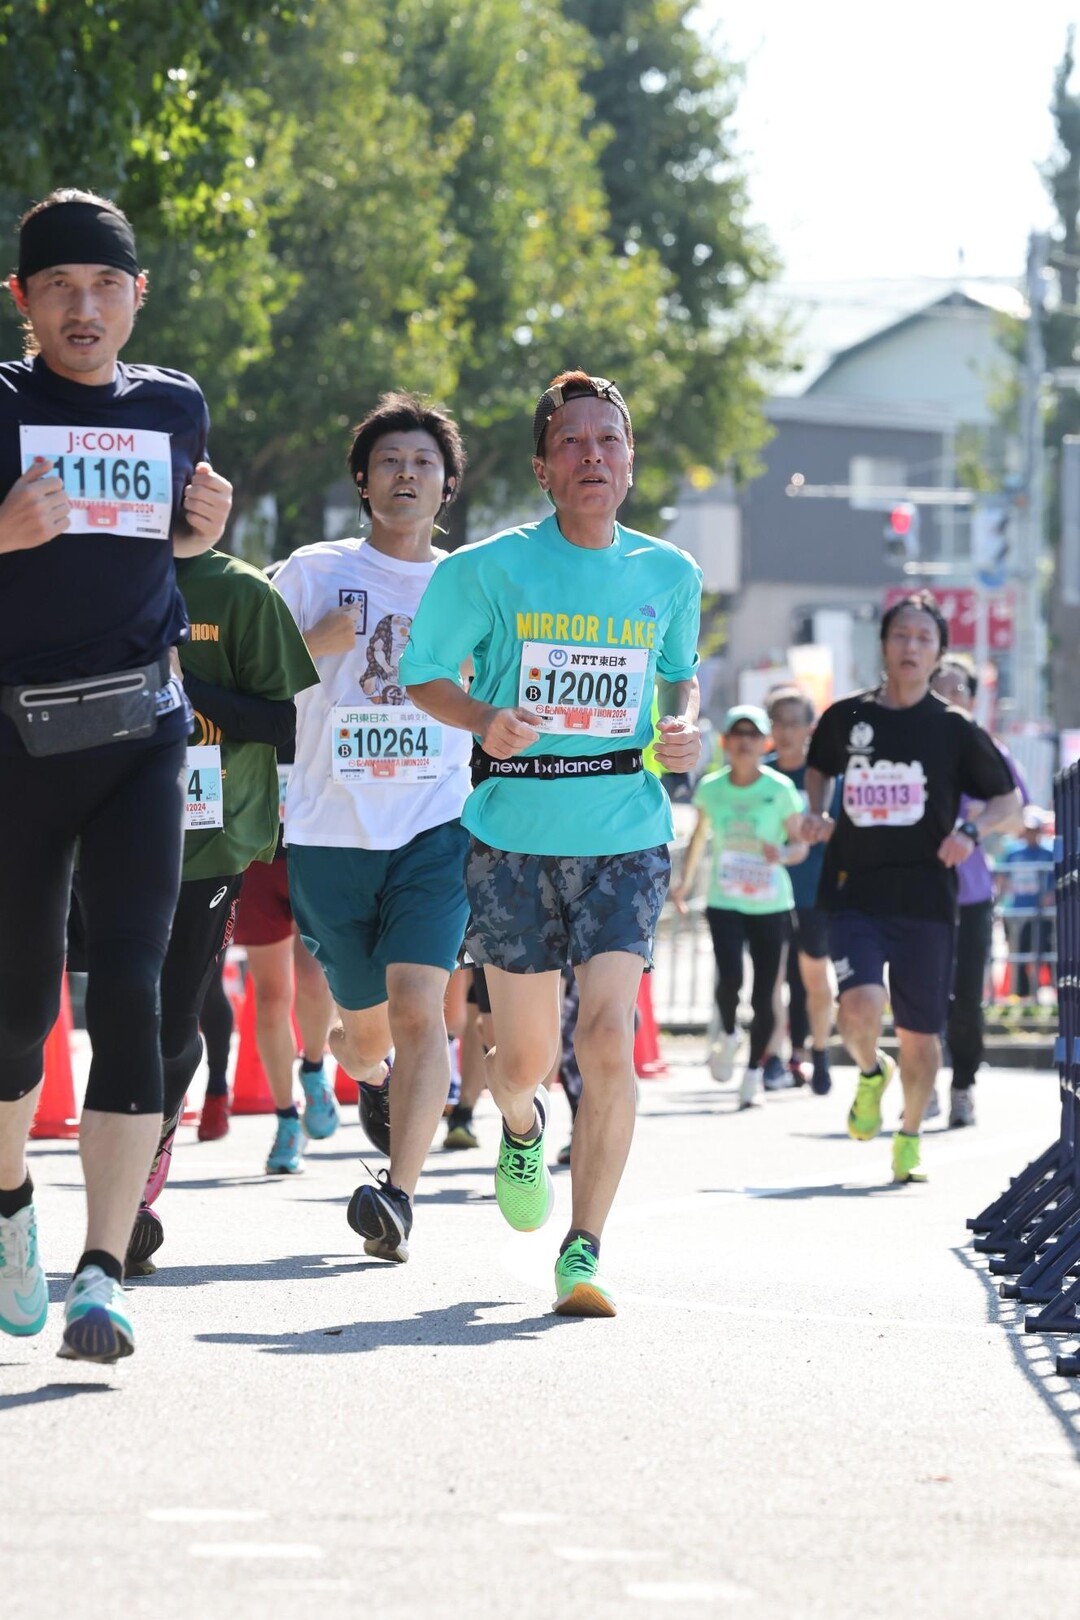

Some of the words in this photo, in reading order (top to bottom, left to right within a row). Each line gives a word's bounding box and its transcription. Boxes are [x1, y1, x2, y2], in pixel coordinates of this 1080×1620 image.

[67, 432, 134, 453] J:COM
[54, 456, 151, 500] 11166
[188, 622, 219, 642] HON
[516, 612, 600, 643] MIRROR
[607, 618, 657, 649] LAKE
[545, 669, 628, 708] 12008
[354, 727, 428, 758] 10264
[489, 761, 529, 774] new
[534, 758, 613, 774] balance
[856, 784, 910, 806] 10313
